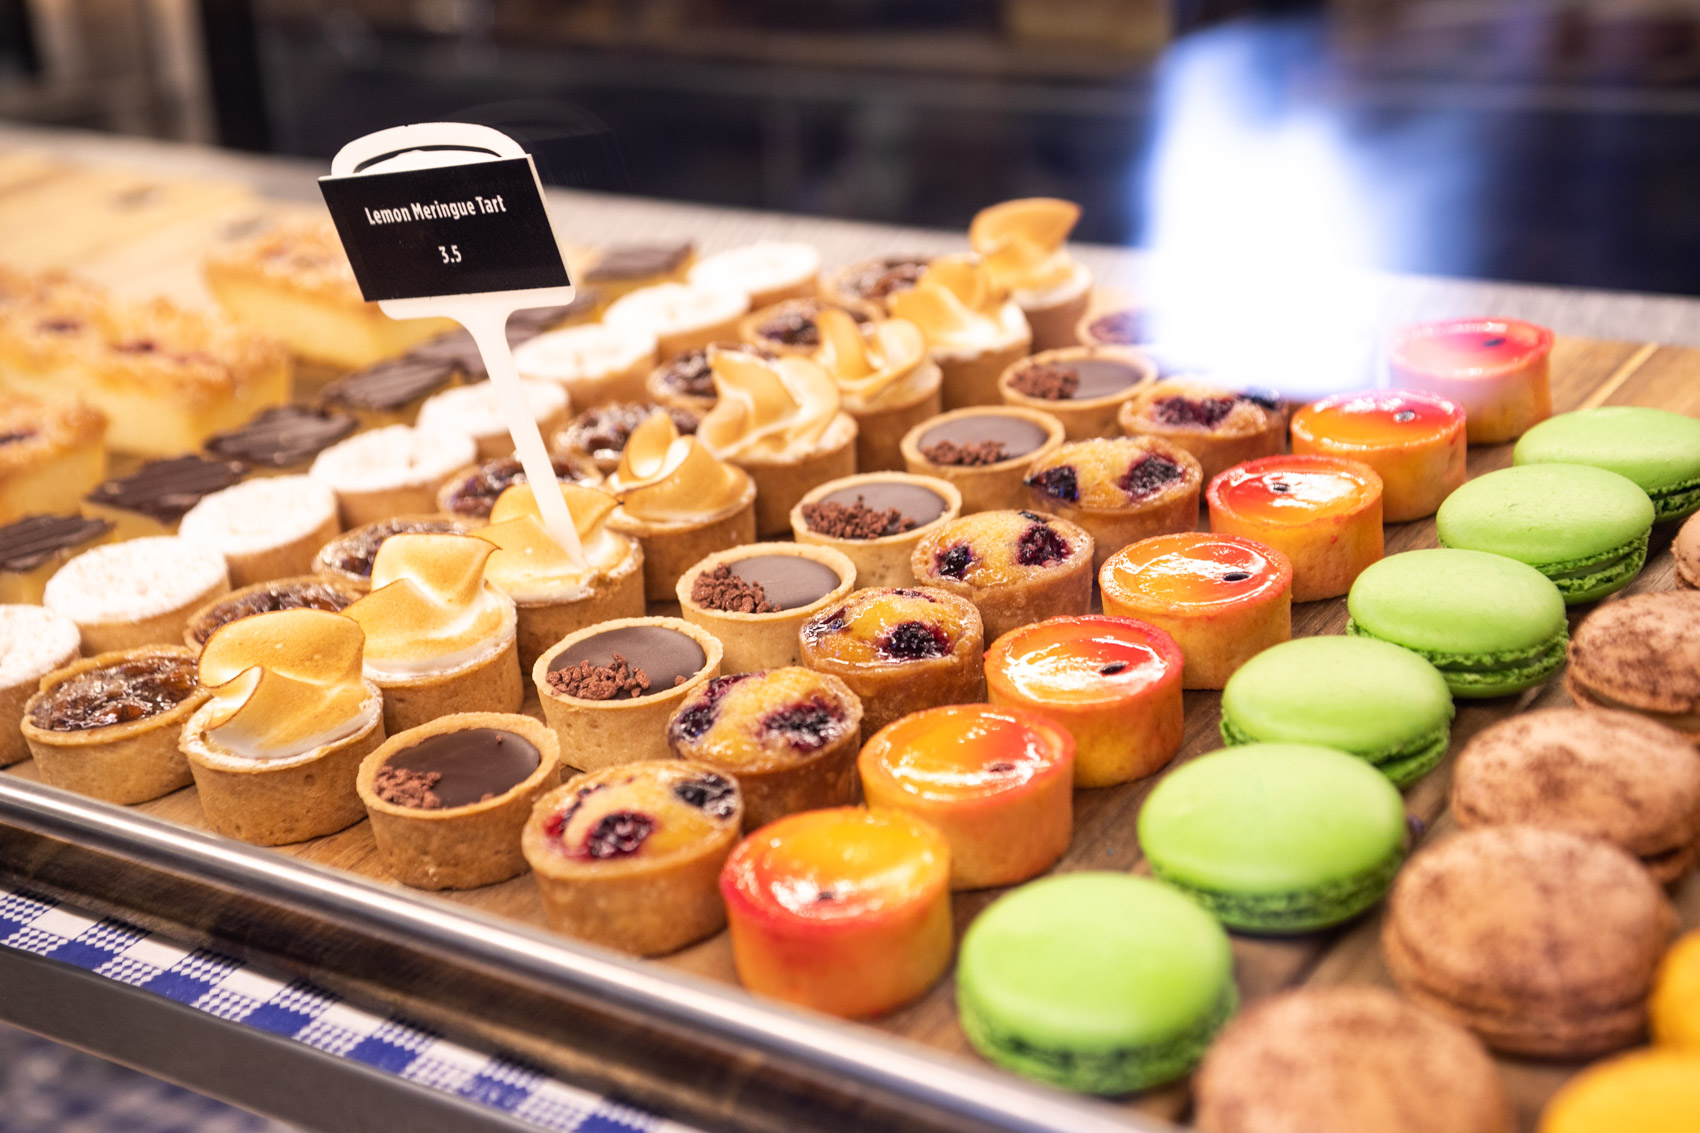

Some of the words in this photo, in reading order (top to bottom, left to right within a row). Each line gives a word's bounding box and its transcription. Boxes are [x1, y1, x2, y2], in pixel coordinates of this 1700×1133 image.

[364, 207, 412, 225] Lemon
[410, 200, 477, 220] Meringue
[474, 194, 507, 214] Tart
[438, 245, 462, 264] 3.5
